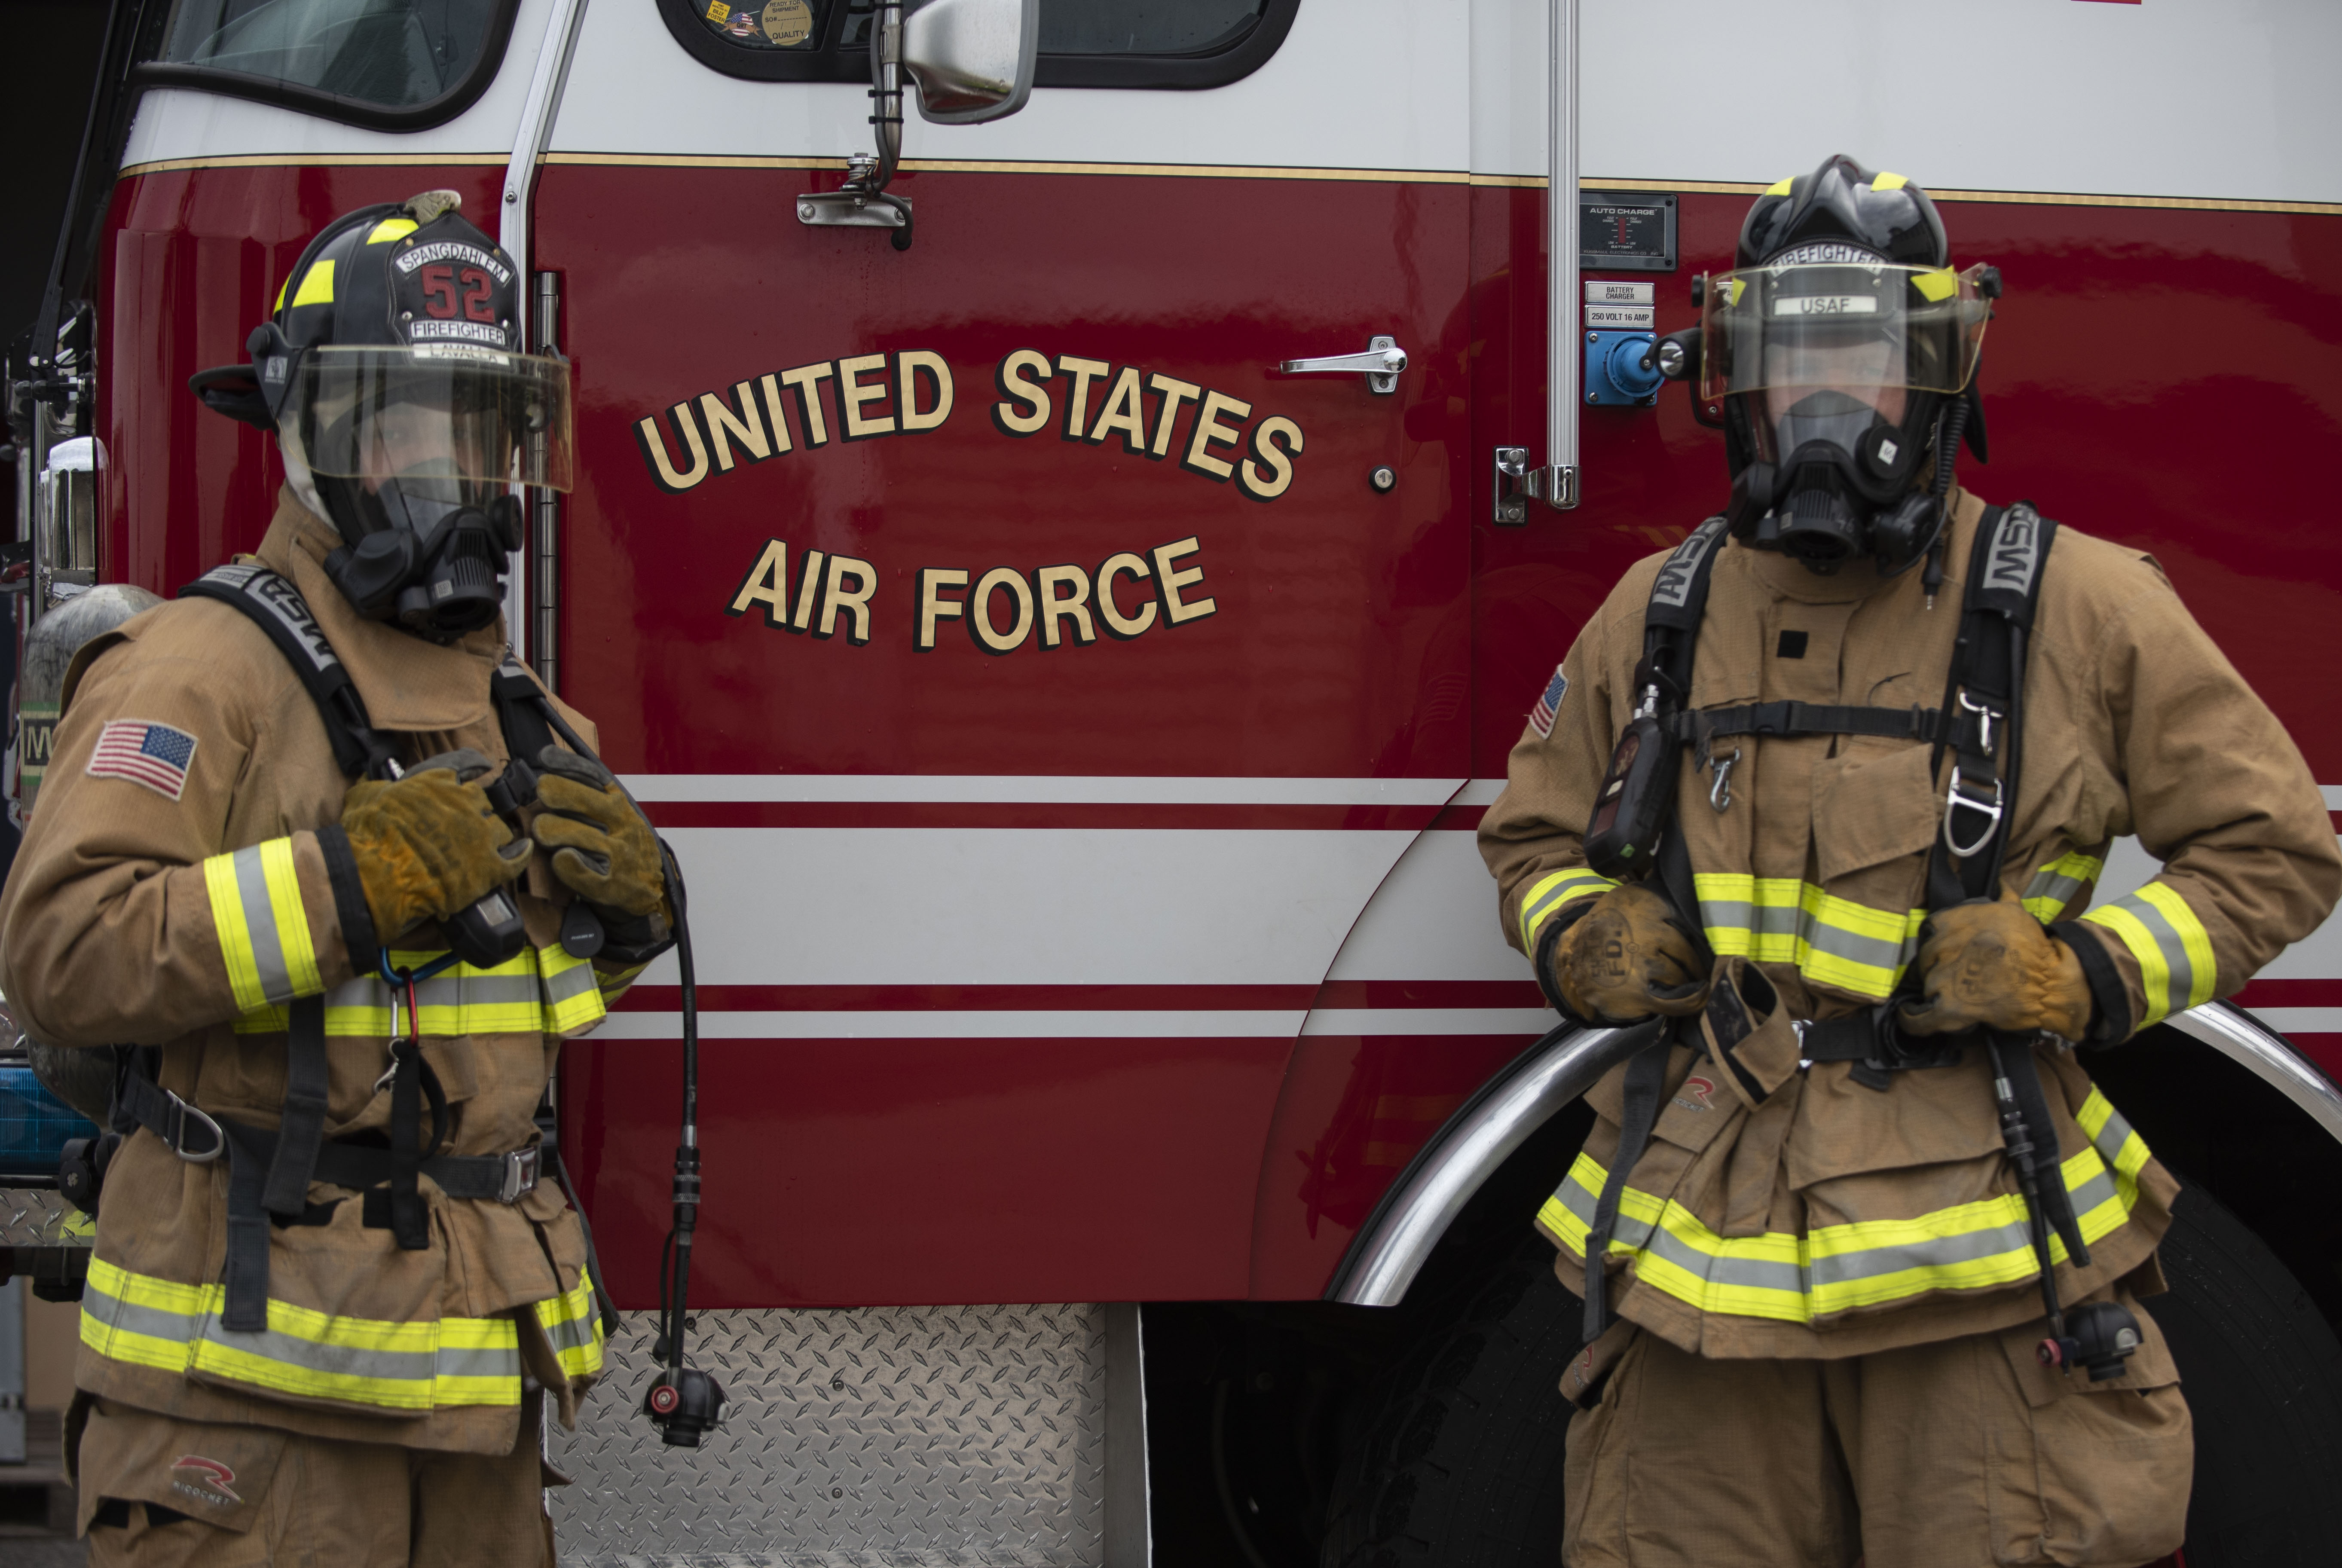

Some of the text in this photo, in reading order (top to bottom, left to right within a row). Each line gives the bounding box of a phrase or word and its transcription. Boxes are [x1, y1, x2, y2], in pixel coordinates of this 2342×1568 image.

[708, 12, 725, 23] FOSTER
[772, 30, 804, 40] QUALITY
[402, 244, 505, 278] SPANGDAHLEM
[421, 265, 495, 322] 52
[1801, 298, 1850, 313] USAF
[414, 322, 504, 345] FIREFIGHTER
[637, 348, 1304, 500] UNITED STATES
[727, 535, 1217, 654] AIR FORCE
